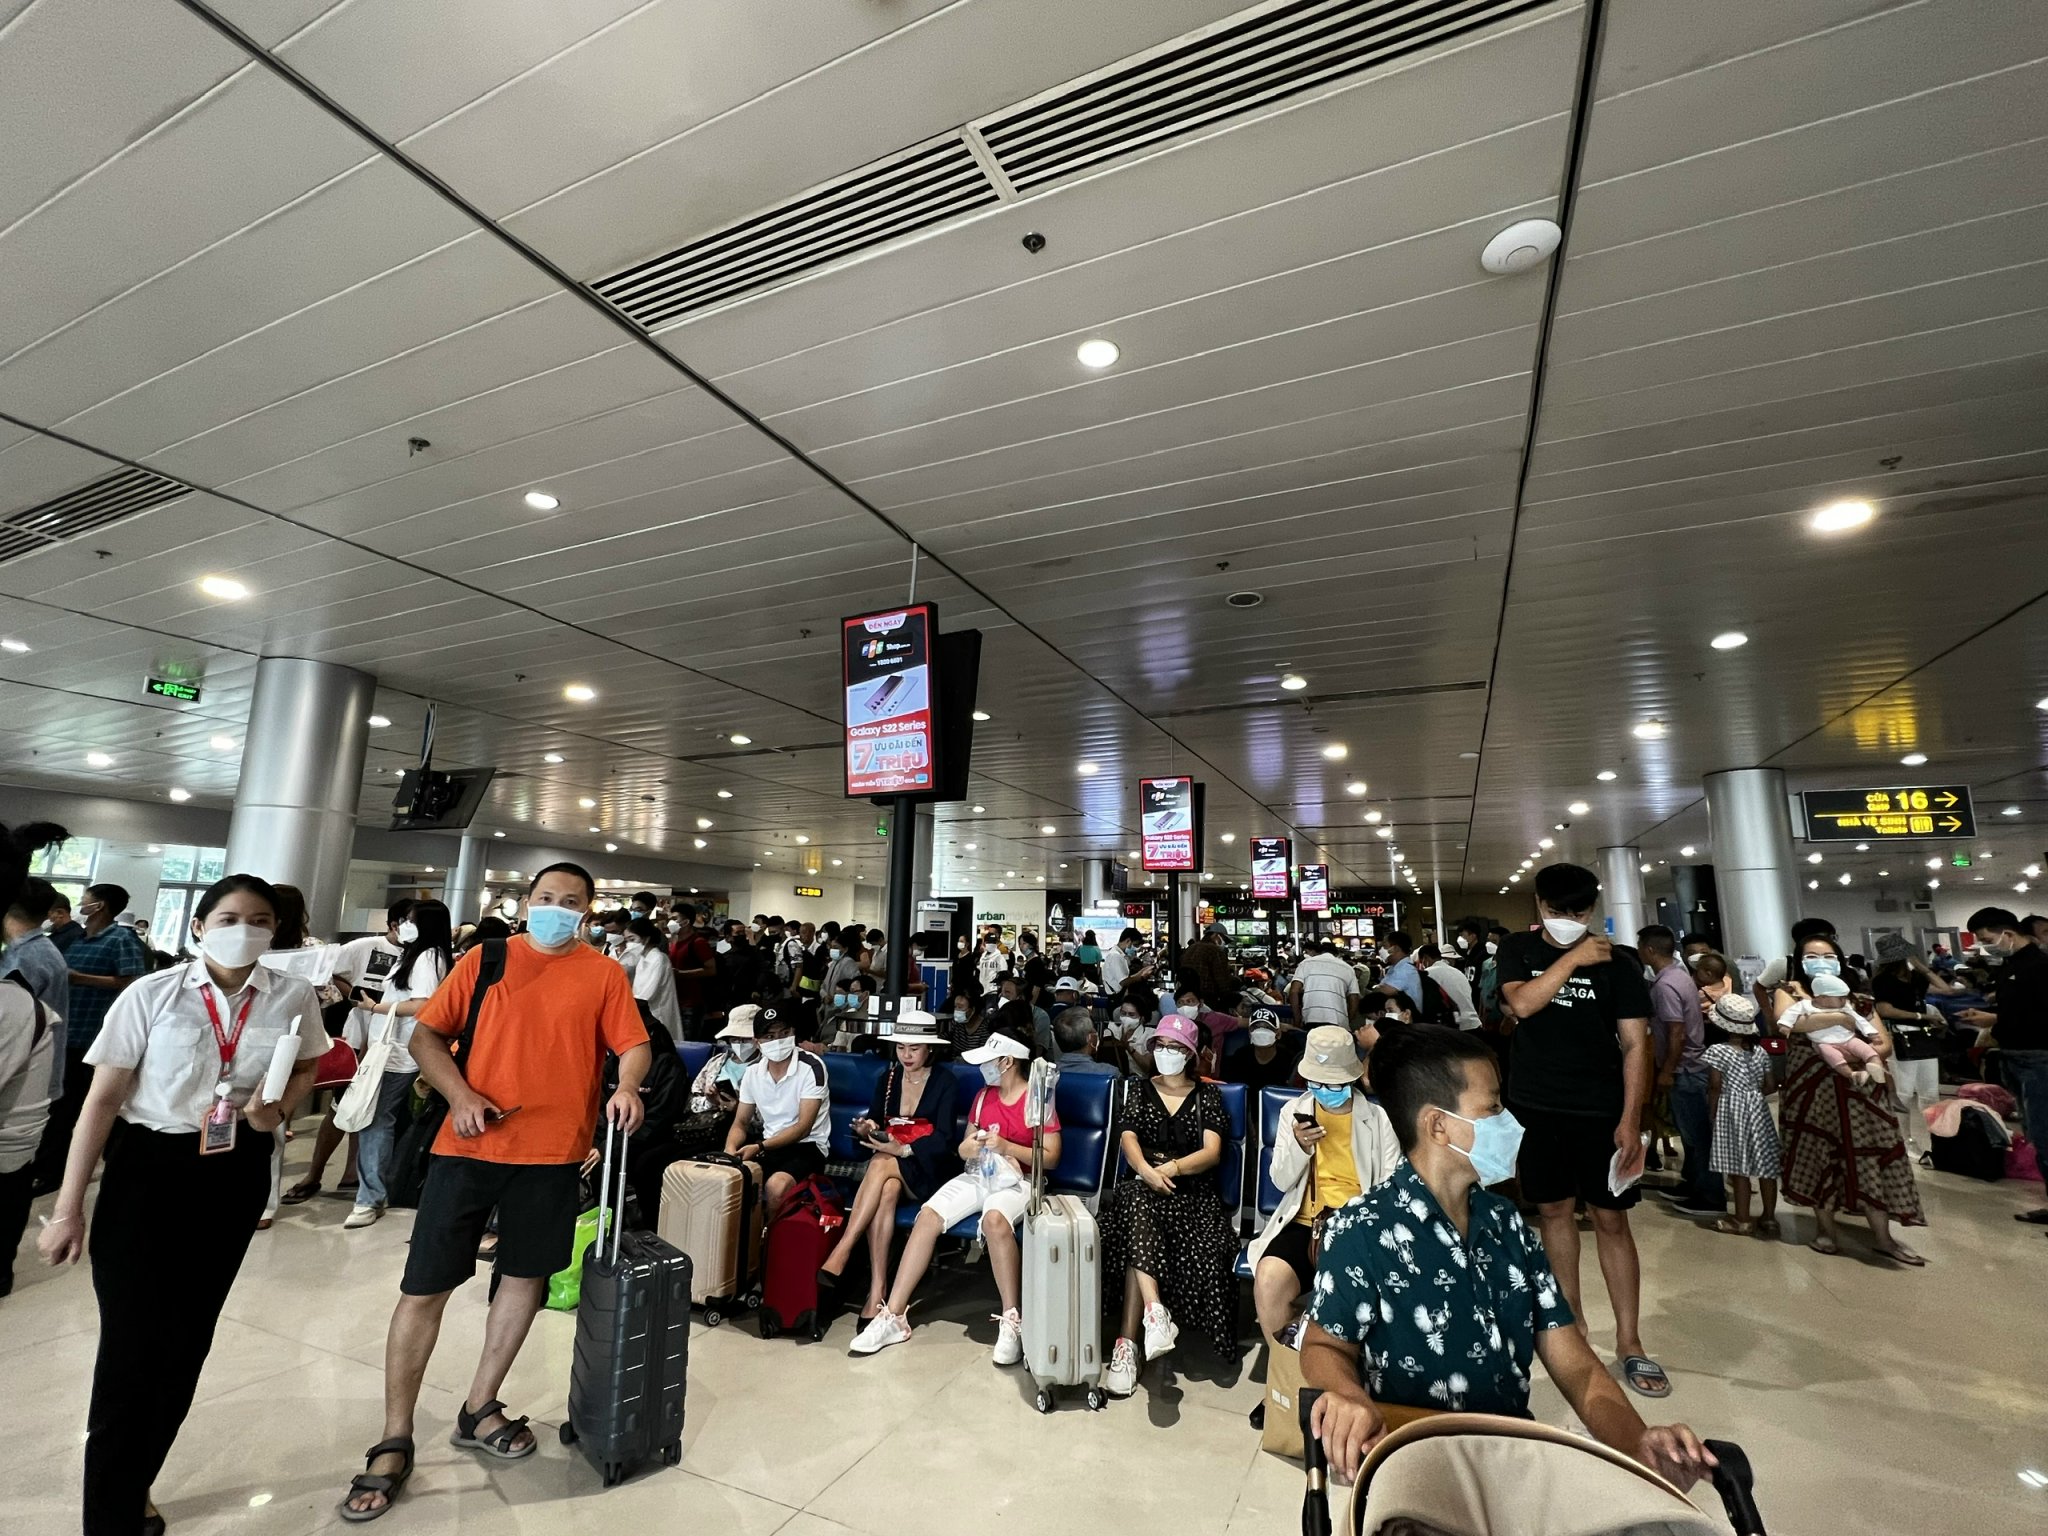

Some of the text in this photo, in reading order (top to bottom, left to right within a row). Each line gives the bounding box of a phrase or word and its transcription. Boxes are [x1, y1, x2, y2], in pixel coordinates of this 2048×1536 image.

[850, 720, 927, 737] Galaxy S22 Series
[854, 743, 873, 771] 7
[876, 750, 924, 772] TRIỆU
[1895, 791, 1929, 810] 16
[1147, 844, 1158, 858] 7
[977, 911, 1005, 921] urban
